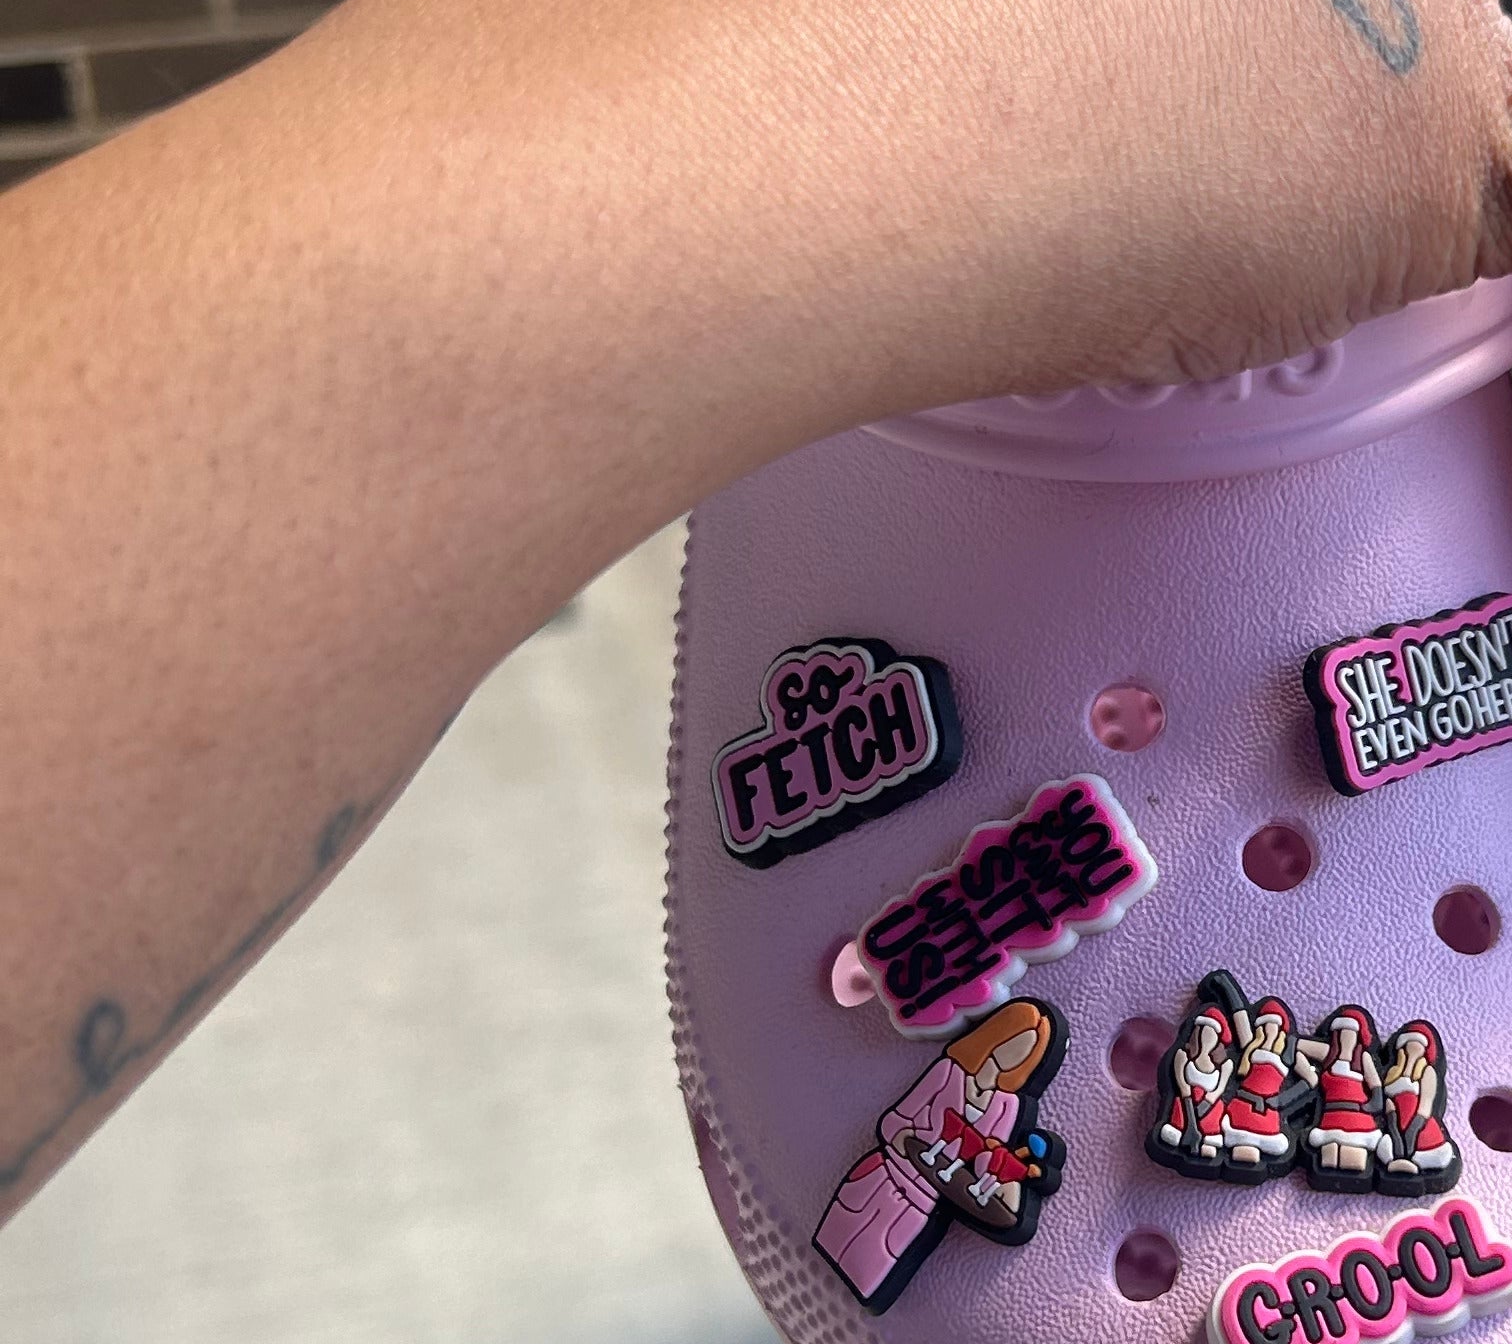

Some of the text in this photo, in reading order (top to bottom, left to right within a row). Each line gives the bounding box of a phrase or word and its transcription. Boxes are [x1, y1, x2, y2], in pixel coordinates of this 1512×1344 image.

[1337, 658, 1406, 729] SHE
[1353, 710, 1429, 771] EVEN
[729, 682, 917, 831] FETCH
[916, 879, 1001, 985] WITH
[960, 845, 1053, 945] SIT
[864, 905, 960, 1019] US!
